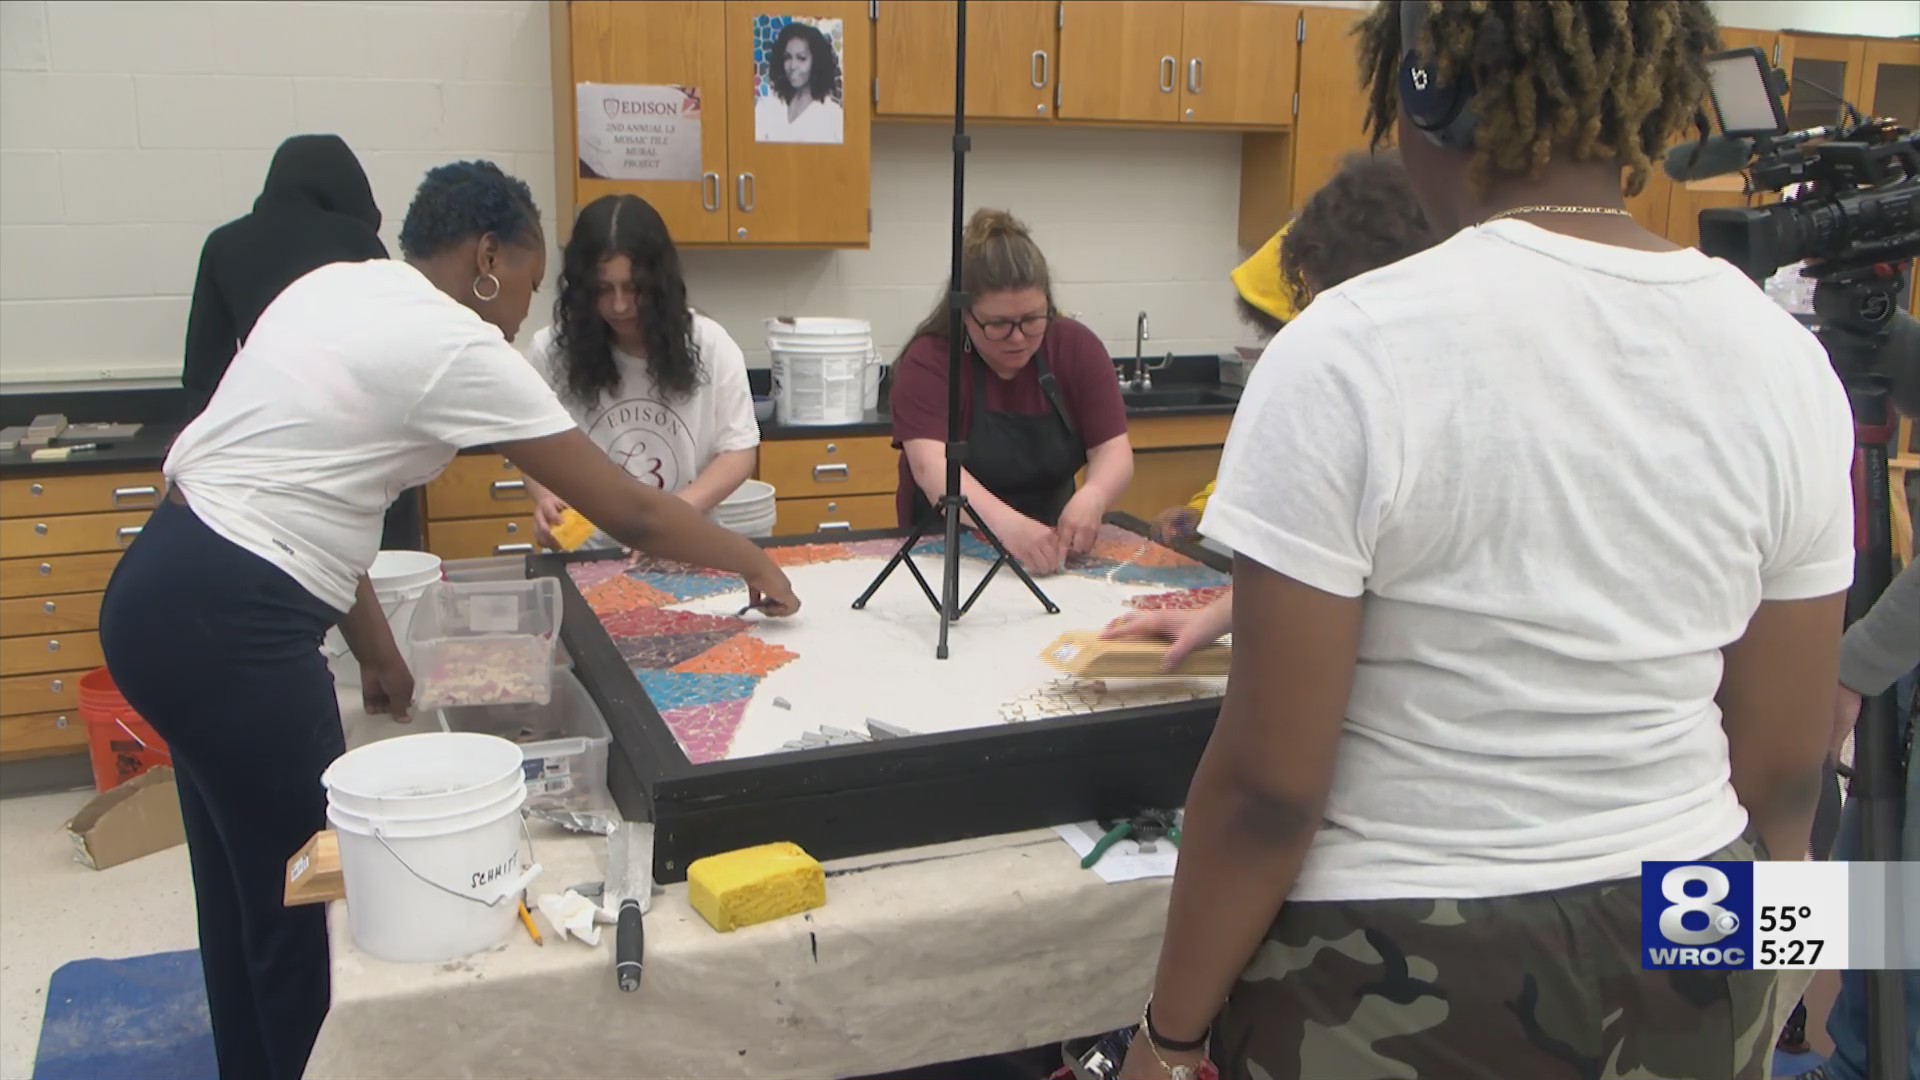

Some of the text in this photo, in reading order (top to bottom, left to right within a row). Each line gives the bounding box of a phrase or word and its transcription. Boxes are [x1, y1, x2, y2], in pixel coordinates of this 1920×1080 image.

[621, 101, 677, 116] EDISON
[605, 123, 624, 133] 2ND
[626, 123, 663, 133] ANNUAL
[650, 136, 669, 145] TILE
[625, 147, 658, 157] MURAL
[623, 159, 661, 169] PROJECT
[606, 406, 682, 436] EDISON
